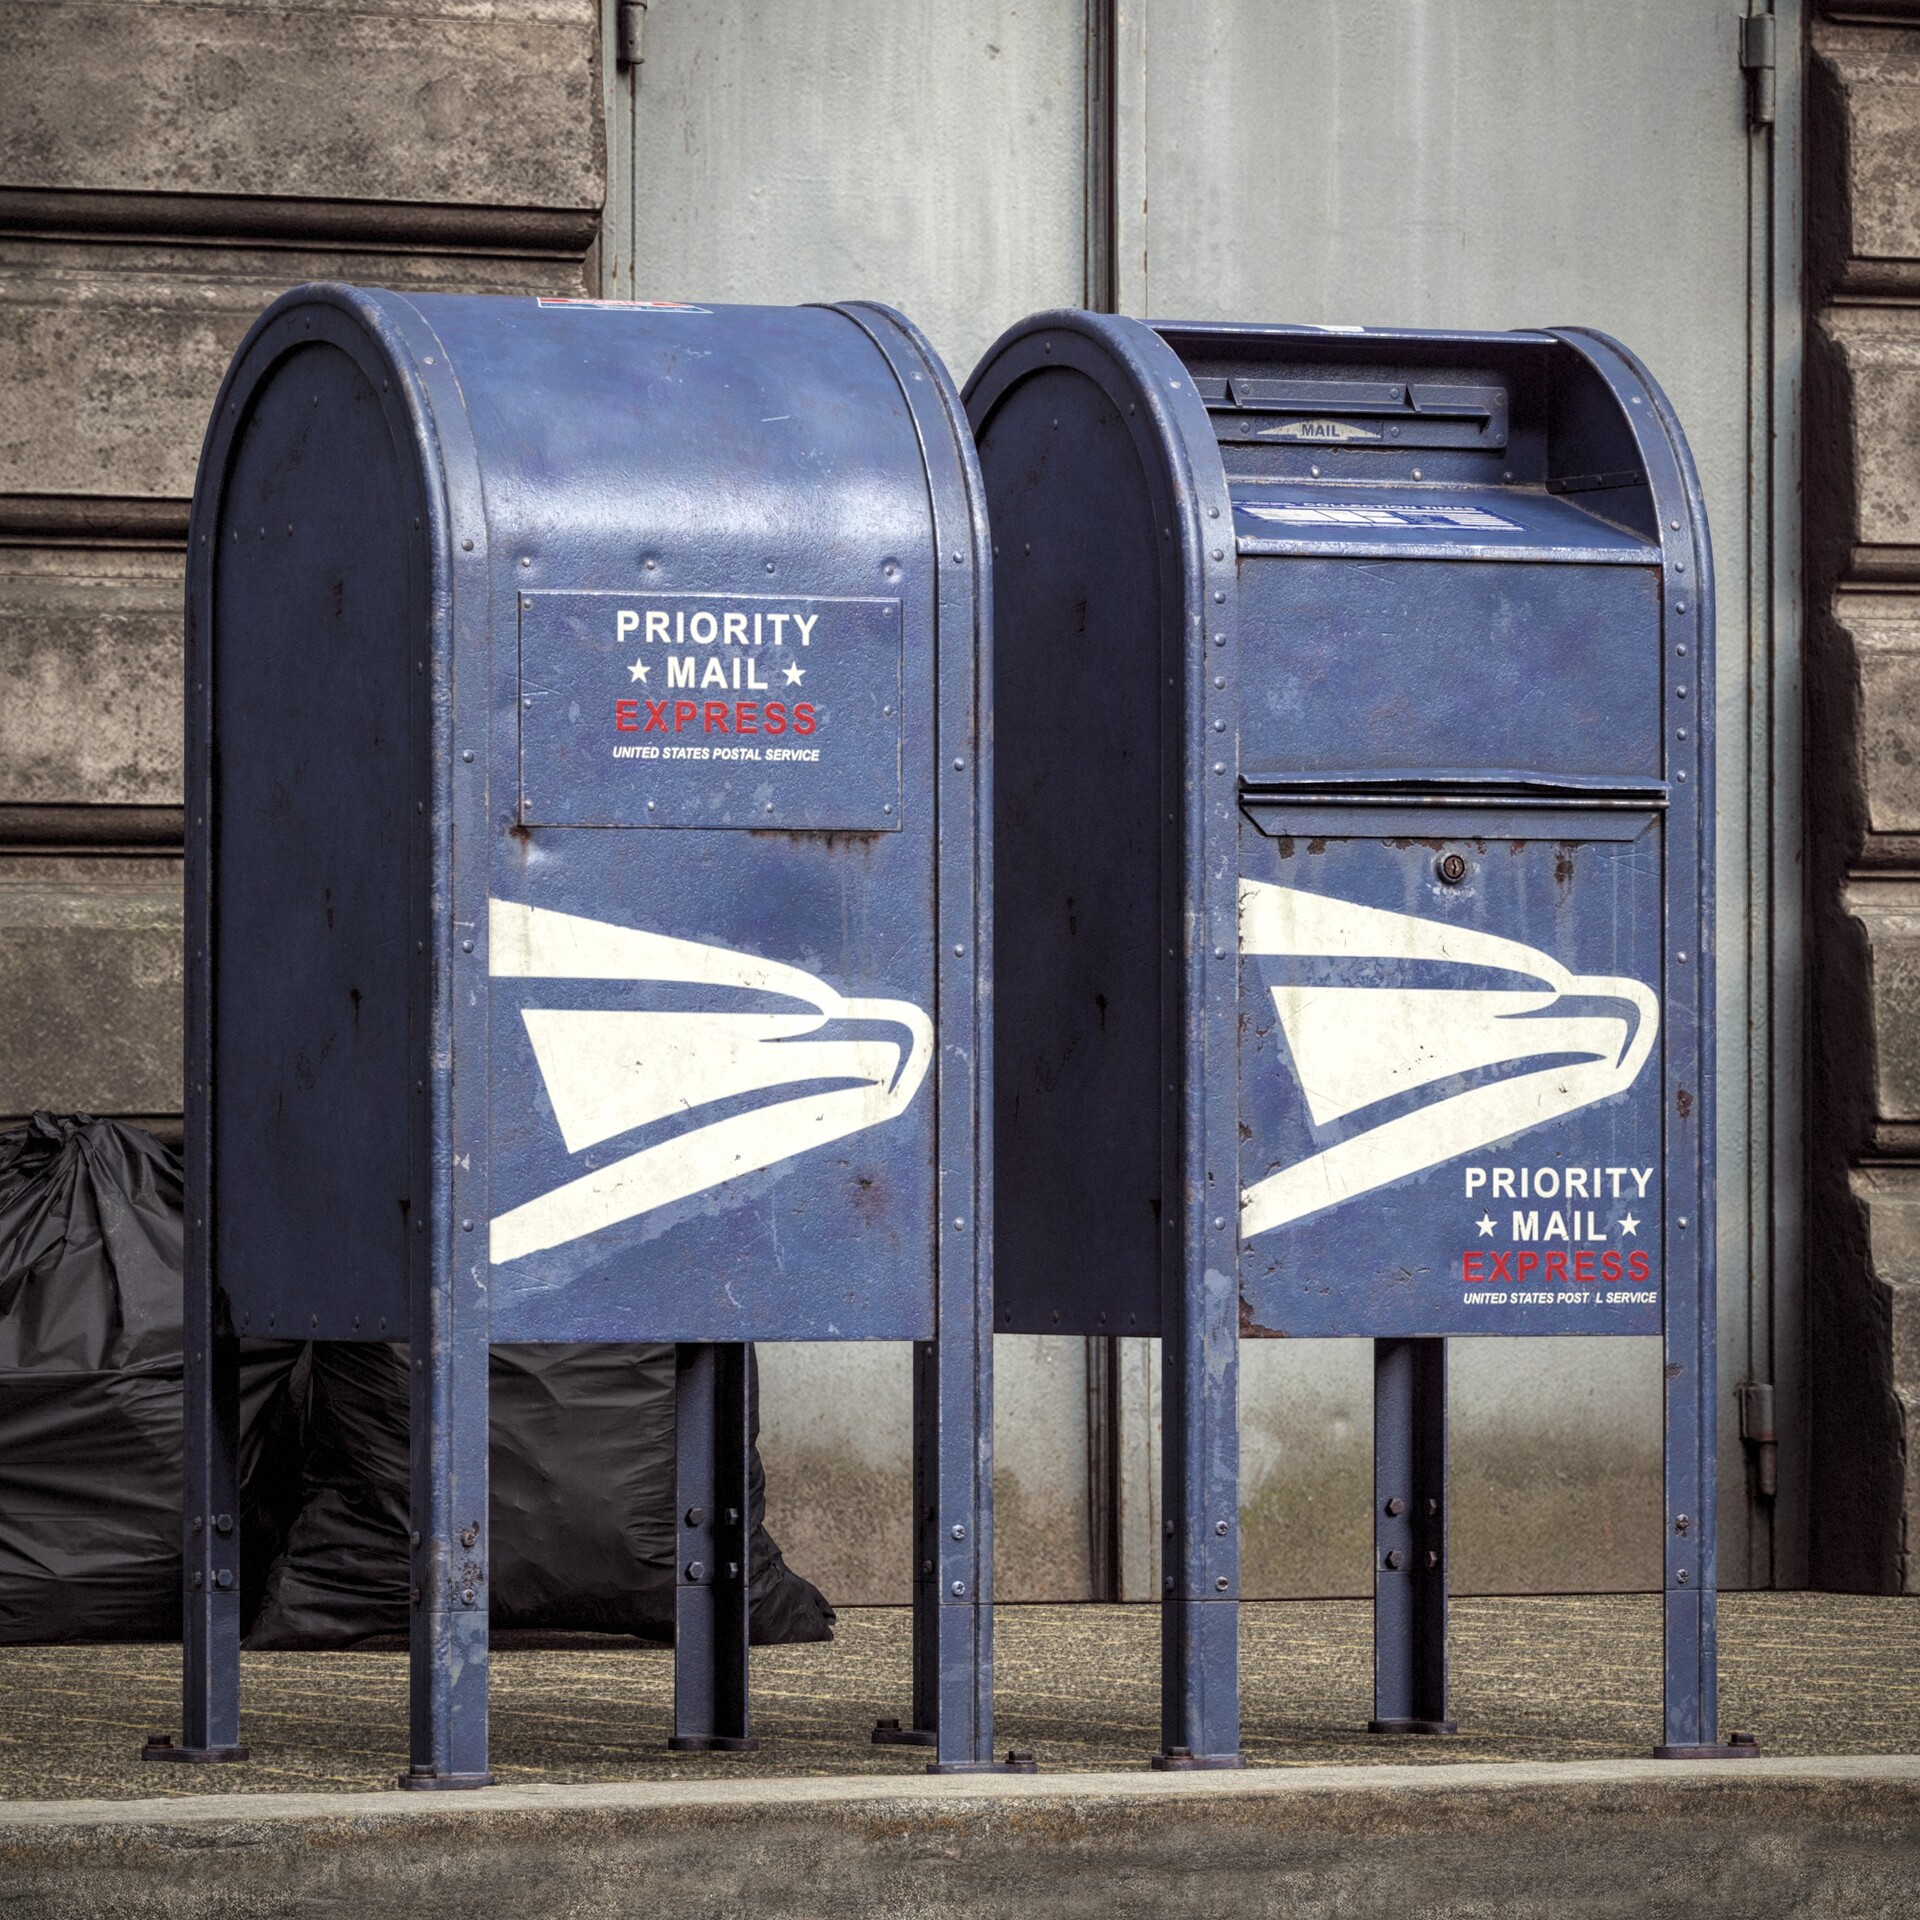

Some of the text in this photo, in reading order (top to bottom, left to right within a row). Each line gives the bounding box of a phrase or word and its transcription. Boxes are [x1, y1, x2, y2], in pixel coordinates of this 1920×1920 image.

[1301, 423, 1341, 437] MAIL
[1302, 502, 1417, 510] COLLECTION
[616, 610, 819, 646] PRIORITY
[667, 656, 768, 690] MAIL
[615, 699, 817, 736] EXPRESS
[612, 745, 820, 762] UNITED STATES POSTAL SERVICE
[1465, 1167, 1654, 1199] PRIORITY
[1512, 1210, 1607, 1242] MAIL
[1462, 1250, 1650, 1283] EXPRESS
[1463, 1291, 1658, 1305] UNITED STATES POSTL SERVICE
